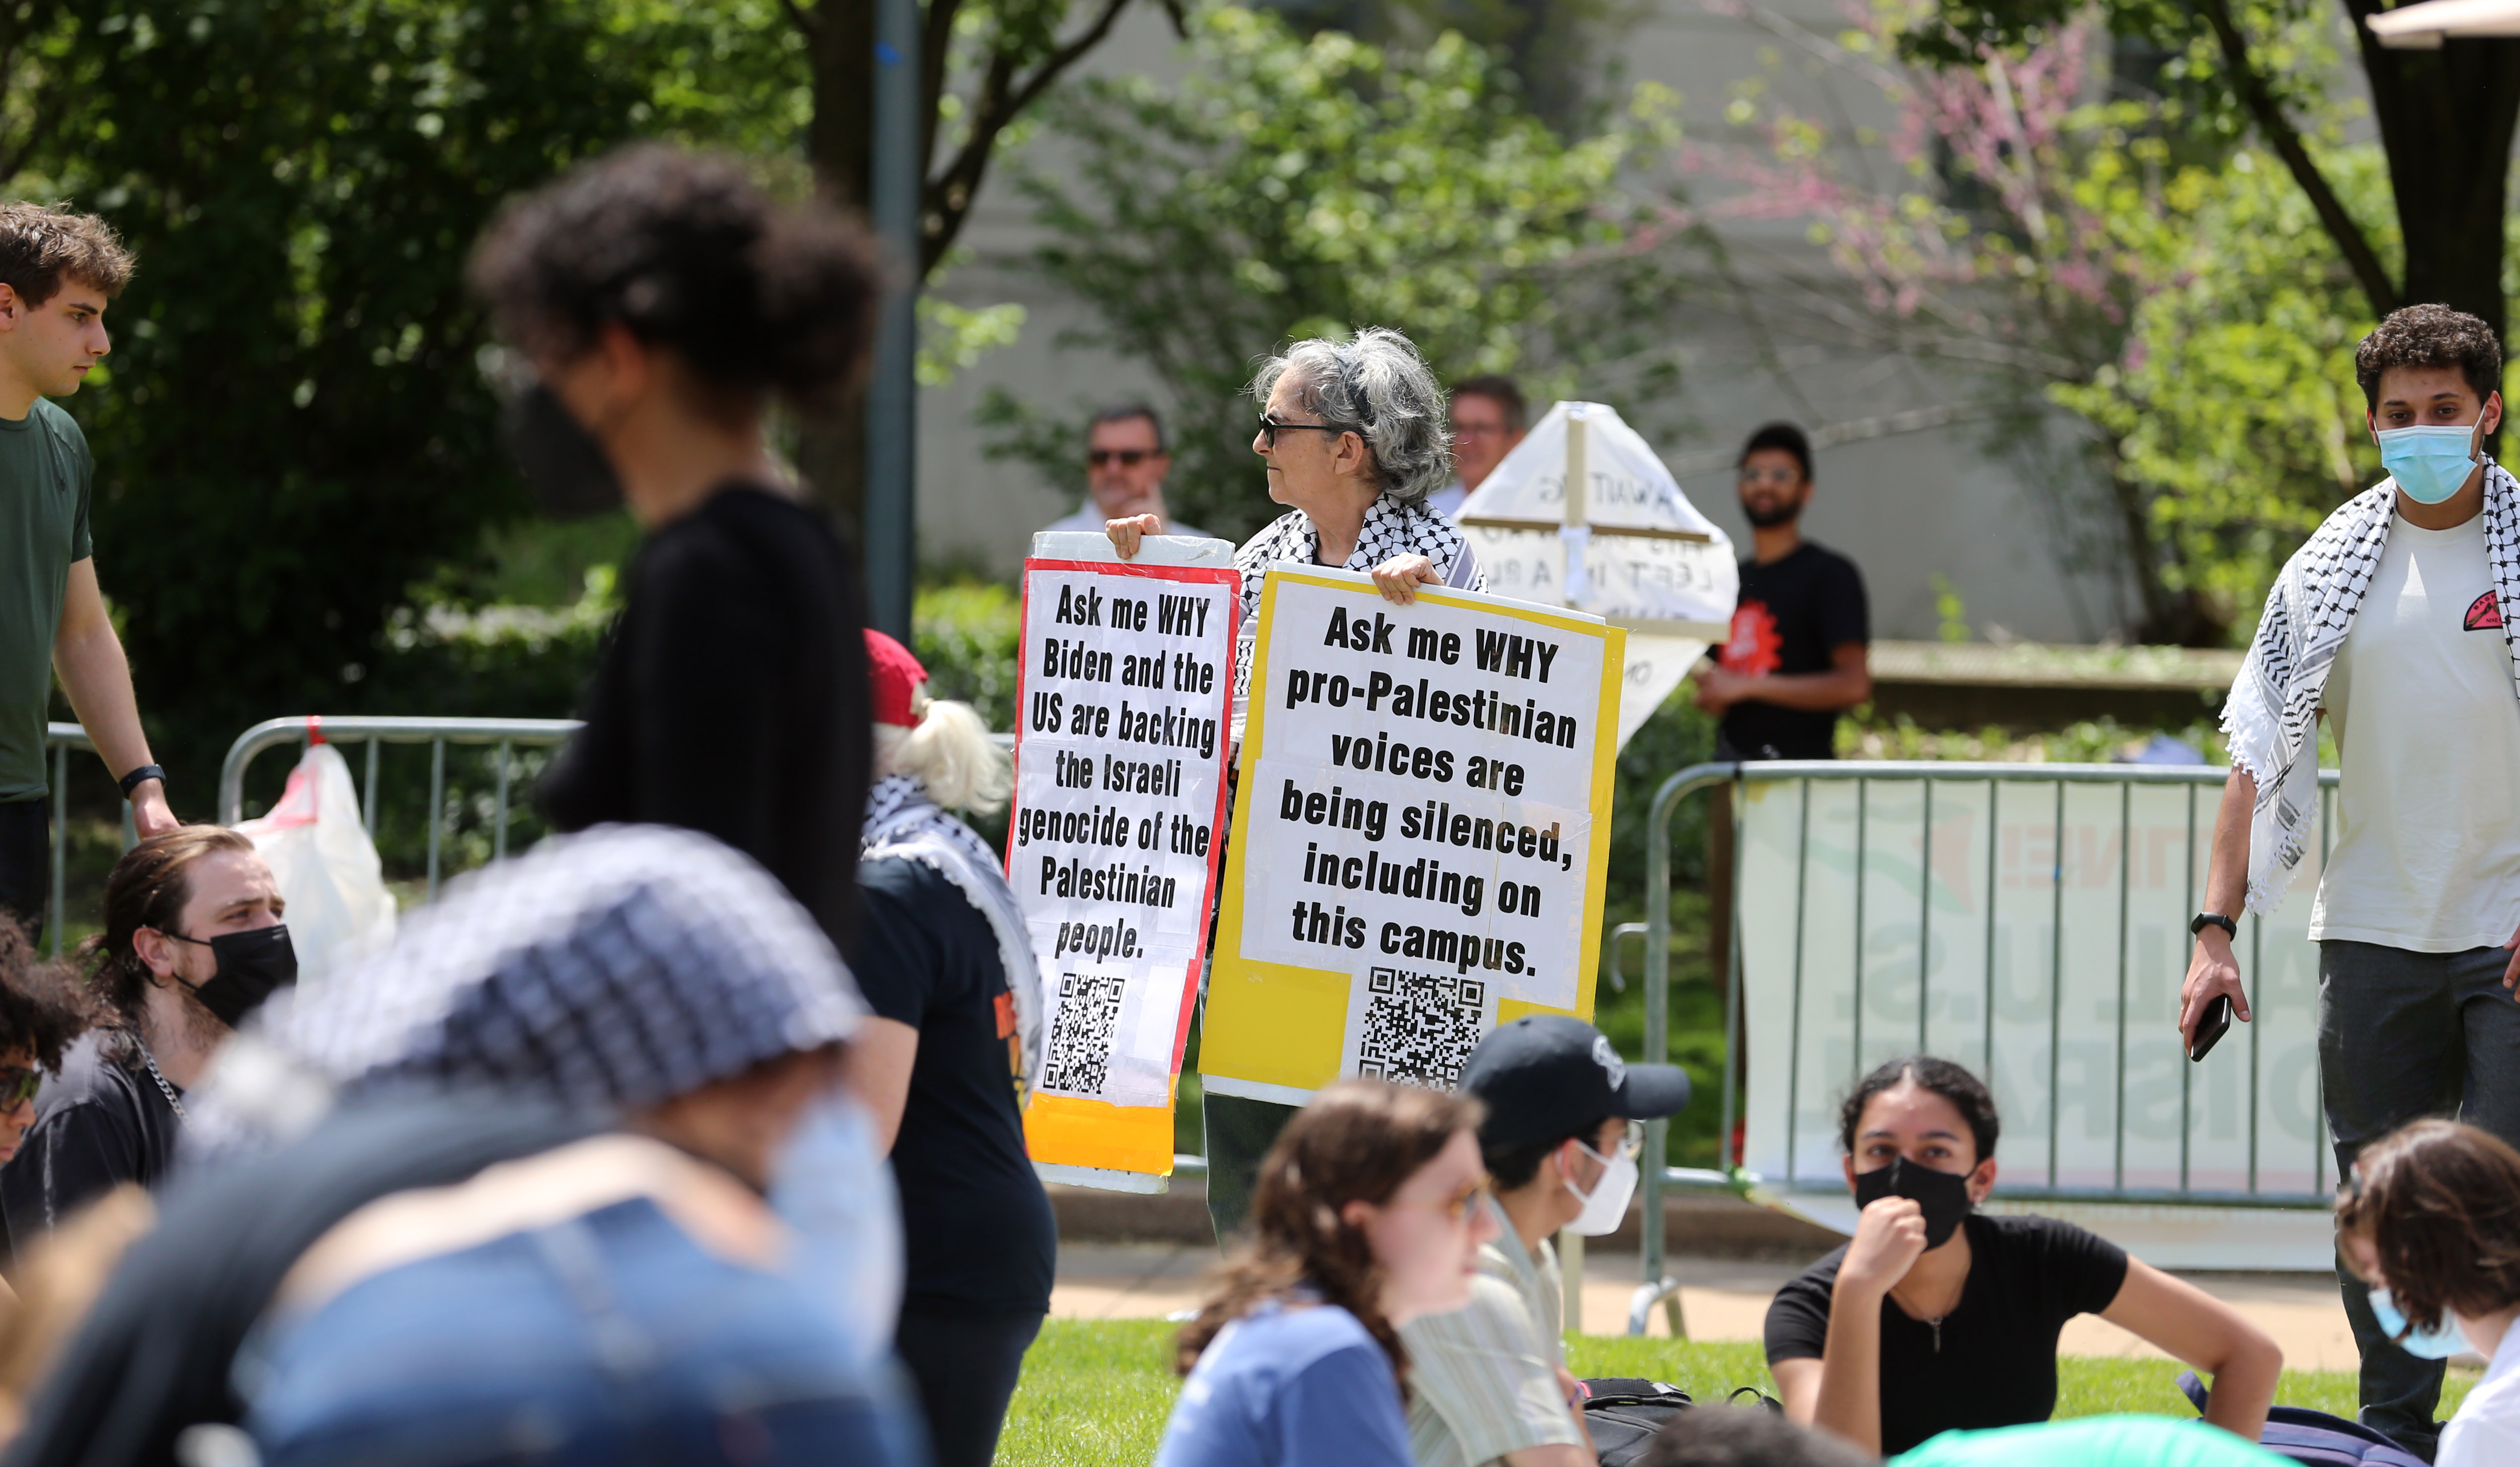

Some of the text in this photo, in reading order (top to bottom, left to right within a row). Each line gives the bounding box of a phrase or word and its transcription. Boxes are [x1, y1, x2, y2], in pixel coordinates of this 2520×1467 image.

[1056, 585, 1210, 637] Ask me WHY
[1044, 638, 1213, 694] Biden and the
[1324, 607, 1559, 683] Ask me WHY
[1033, 692, 1215, 759] US are backing
[1286, 670, 1576, 749] pro-Palestinian
[1056, 751, 1181, 797] the Israeli
[1332, 732, 1524, 796] voices are
[1019, 805, 1209, 857] genocide of the
[1280, 779, 1572, 872] being silenced,
[1041, 856, 1175, 908] Palestinian
[1304, 842, 1540, 917] including on
[1055, 918, 1143, 964] people.
[1292, 902, 1536, 977] this campus.
